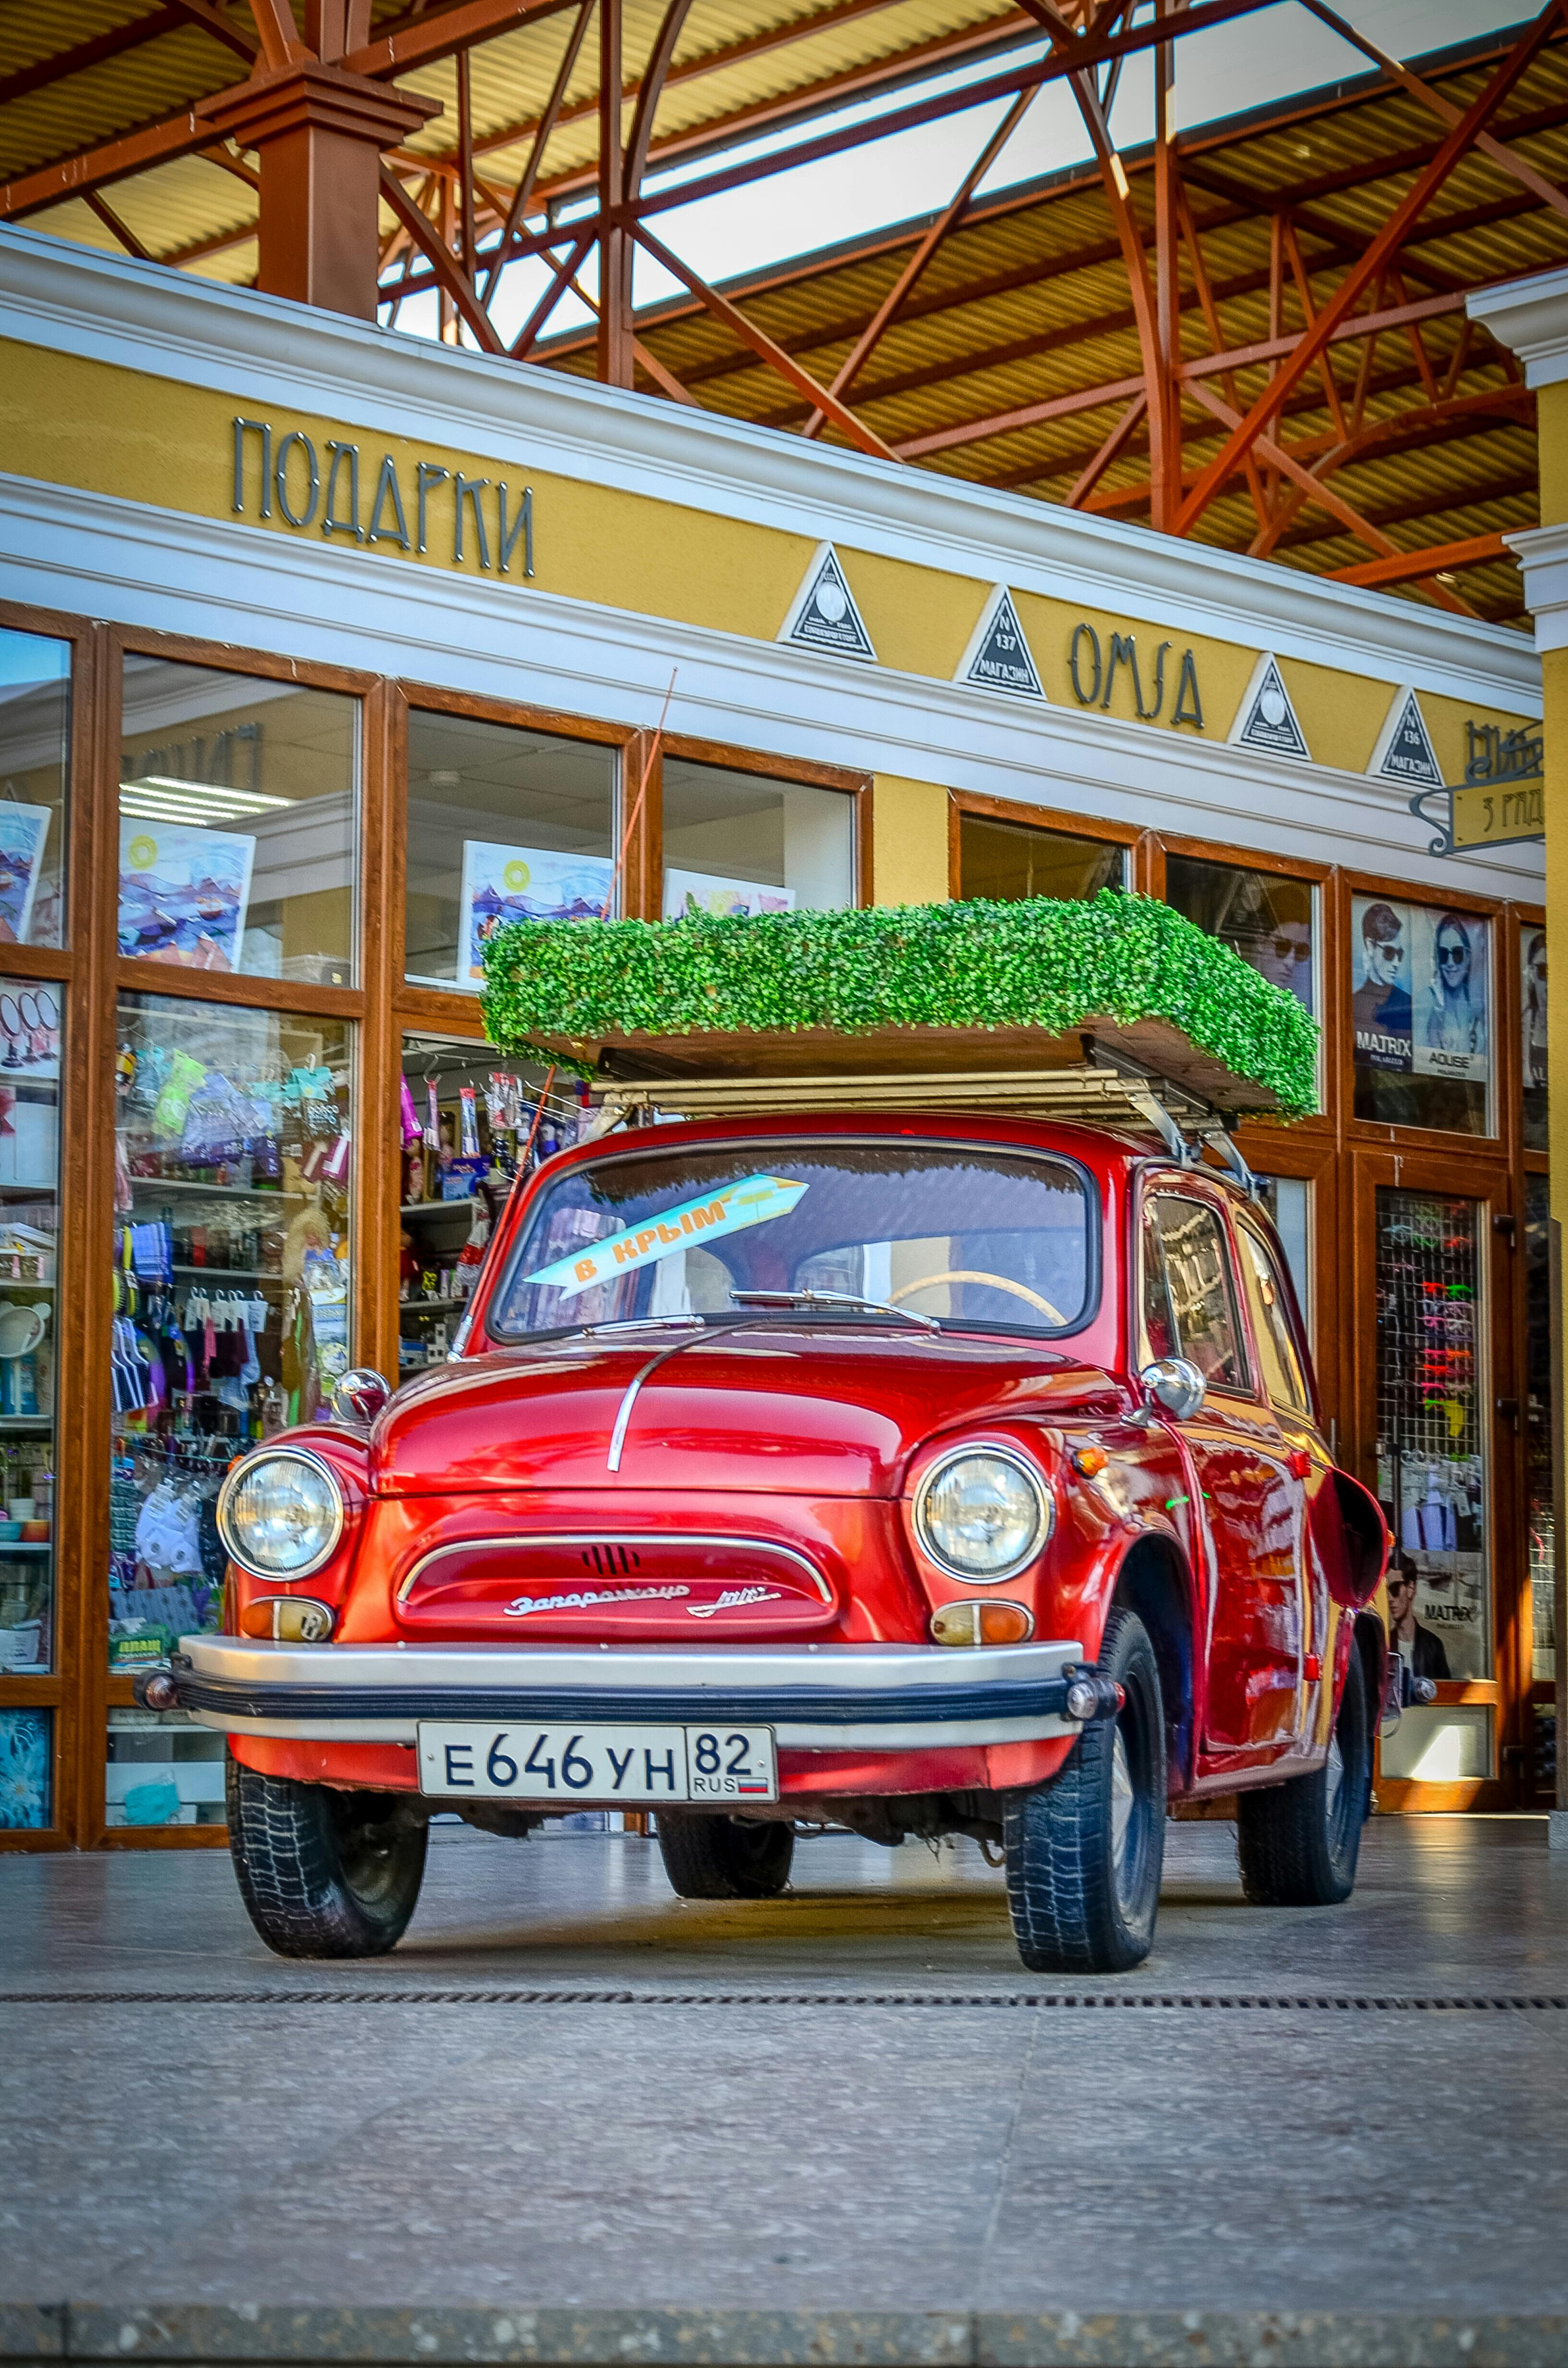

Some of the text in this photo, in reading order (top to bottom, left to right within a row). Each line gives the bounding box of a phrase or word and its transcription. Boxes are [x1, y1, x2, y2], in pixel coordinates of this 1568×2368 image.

[233, 416, 535, 578] ПОДАРКИ
[999, 614, 1011, 631] N
[995, 632, 1016, 651] 137
[979, 659, 1030, 683] МАГАЗИН
[1067, 623, 1205, 729] OMSA
[1404, 730, 1421, 745] 136
[1390, 753, 1432, 776] МАГАЗИН
[1356, 1030, 1412, 1057] MATRIX
[611, 1207, 727, 1264] КРЫМ
[695, 1733, 752, 1776] 82
[694, 1777, 736, 1793] RUS
